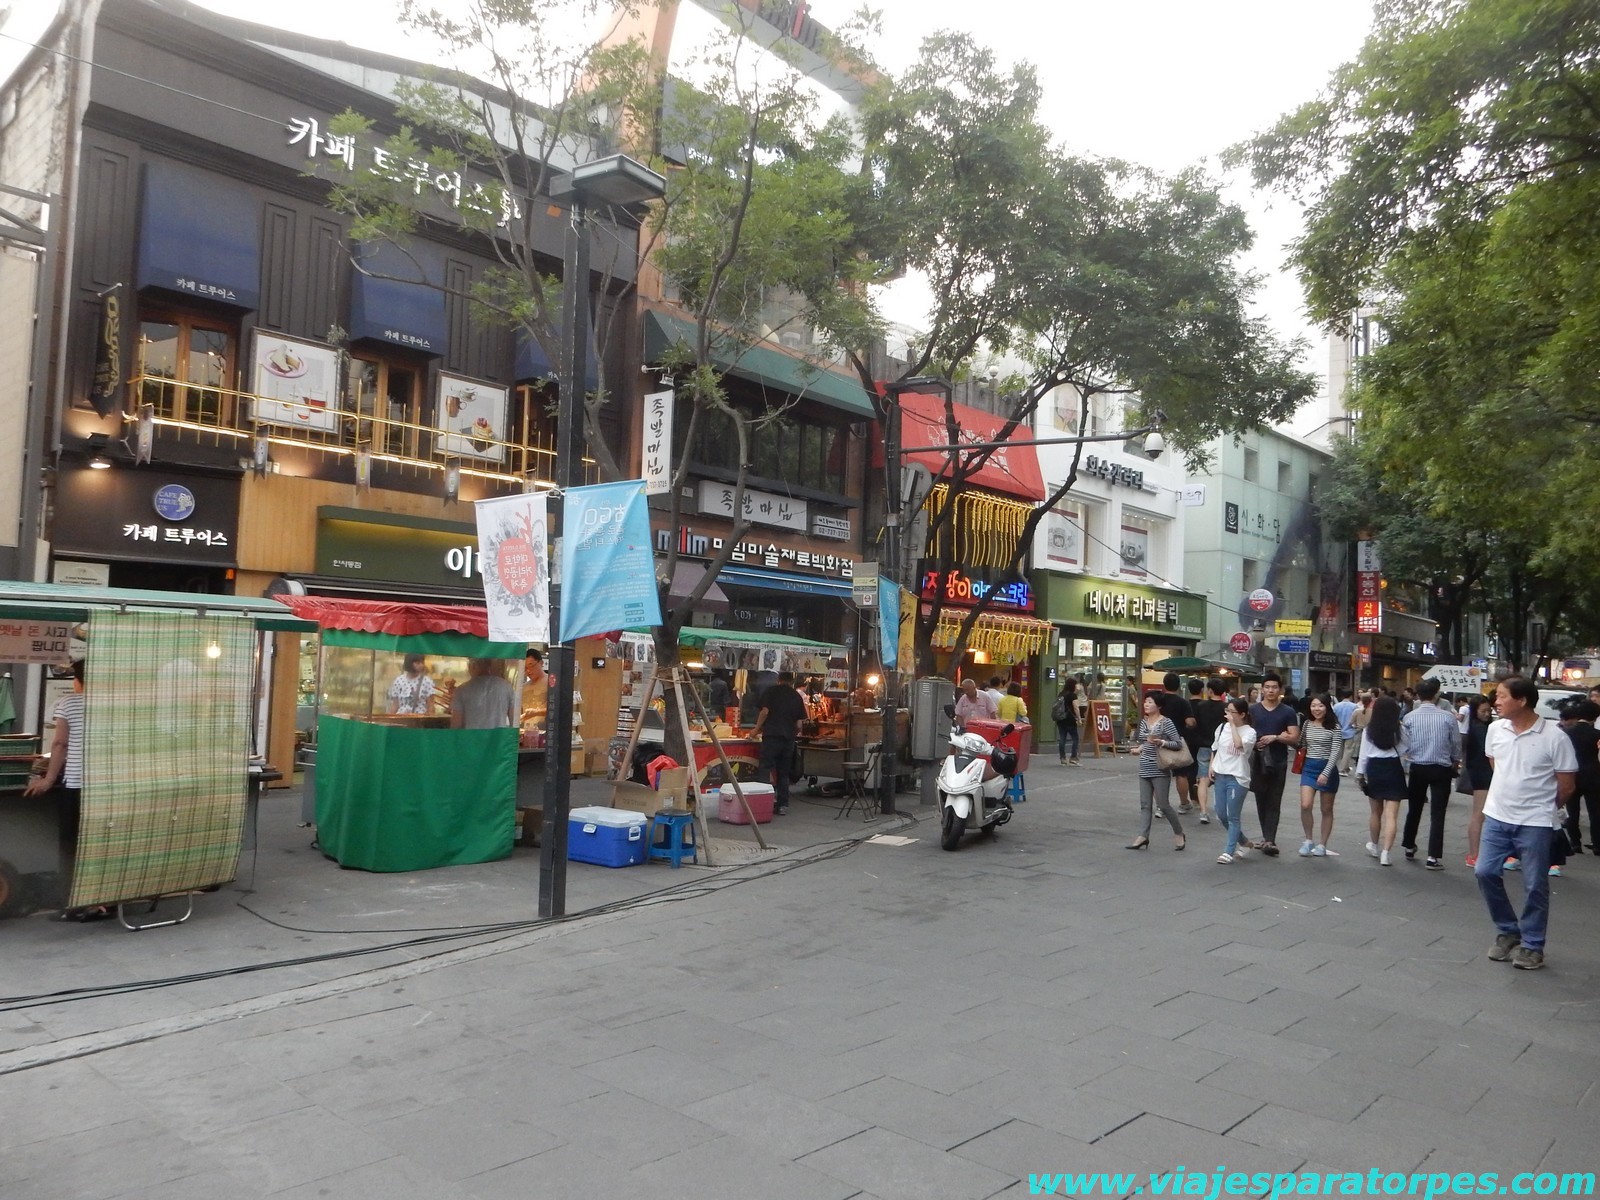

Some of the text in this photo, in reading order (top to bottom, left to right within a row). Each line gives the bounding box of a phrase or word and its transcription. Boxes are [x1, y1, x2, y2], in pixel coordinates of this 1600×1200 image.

[287, 117, 356, 171] 카페
[176, 278, 237, 301] 카페 트루어스
[384, 330, 431, 348] 카페 트루어스
[122, 523, 228, 547] 카페 트루어스
[1089, 589, 1179, 625] 네이처 리퍼블릭
[1363, 602, 1373, 617] 사주
[28, 625, 40, 638] 돈
[44, 626, 68, 638] 사고
[31, 640, 68, 653] 팝니다
[1096, 714, 1110, 732] 50
